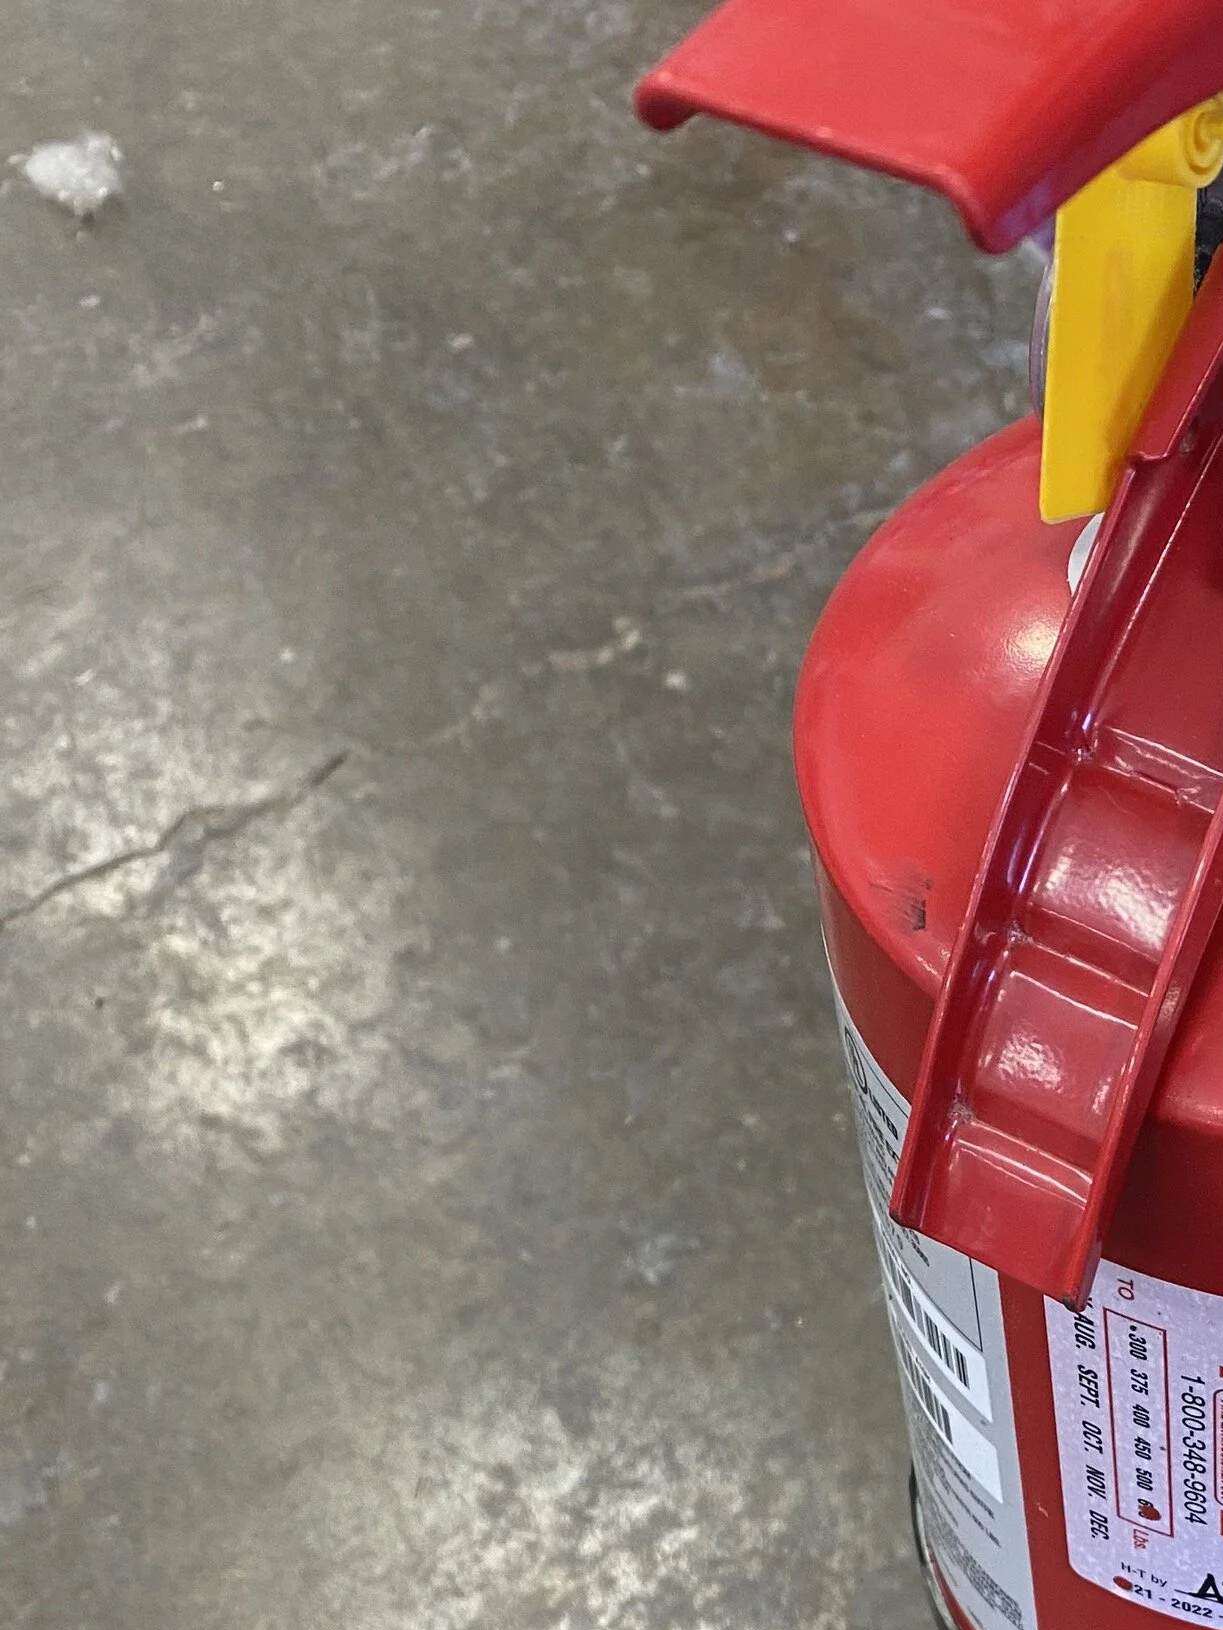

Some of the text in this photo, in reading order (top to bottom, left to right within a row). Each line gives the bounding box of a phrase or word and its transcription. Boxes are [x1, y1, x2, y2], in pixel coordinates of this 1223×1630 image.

[1117, 1279, 1135, 1301] TO
[1130, 1368, 1149, 1396] 375
[1073, 1311, 1110, 1541] AUG. SEPT. OCT. NOV. DEC.
[1132, 1403, 1150, 1429] 400
[1134, 1436, 1152, 1461] 450
[1180, 1375, 1208, 1526] 1-800-348-9604
[1135, 1467, 1154, 1492] 500
[1120, 1561, 1168, 1588] H-T by
[1134, 1584, 1153, 1600] 21
[1171, 1597, 1213, 1619] 2022
